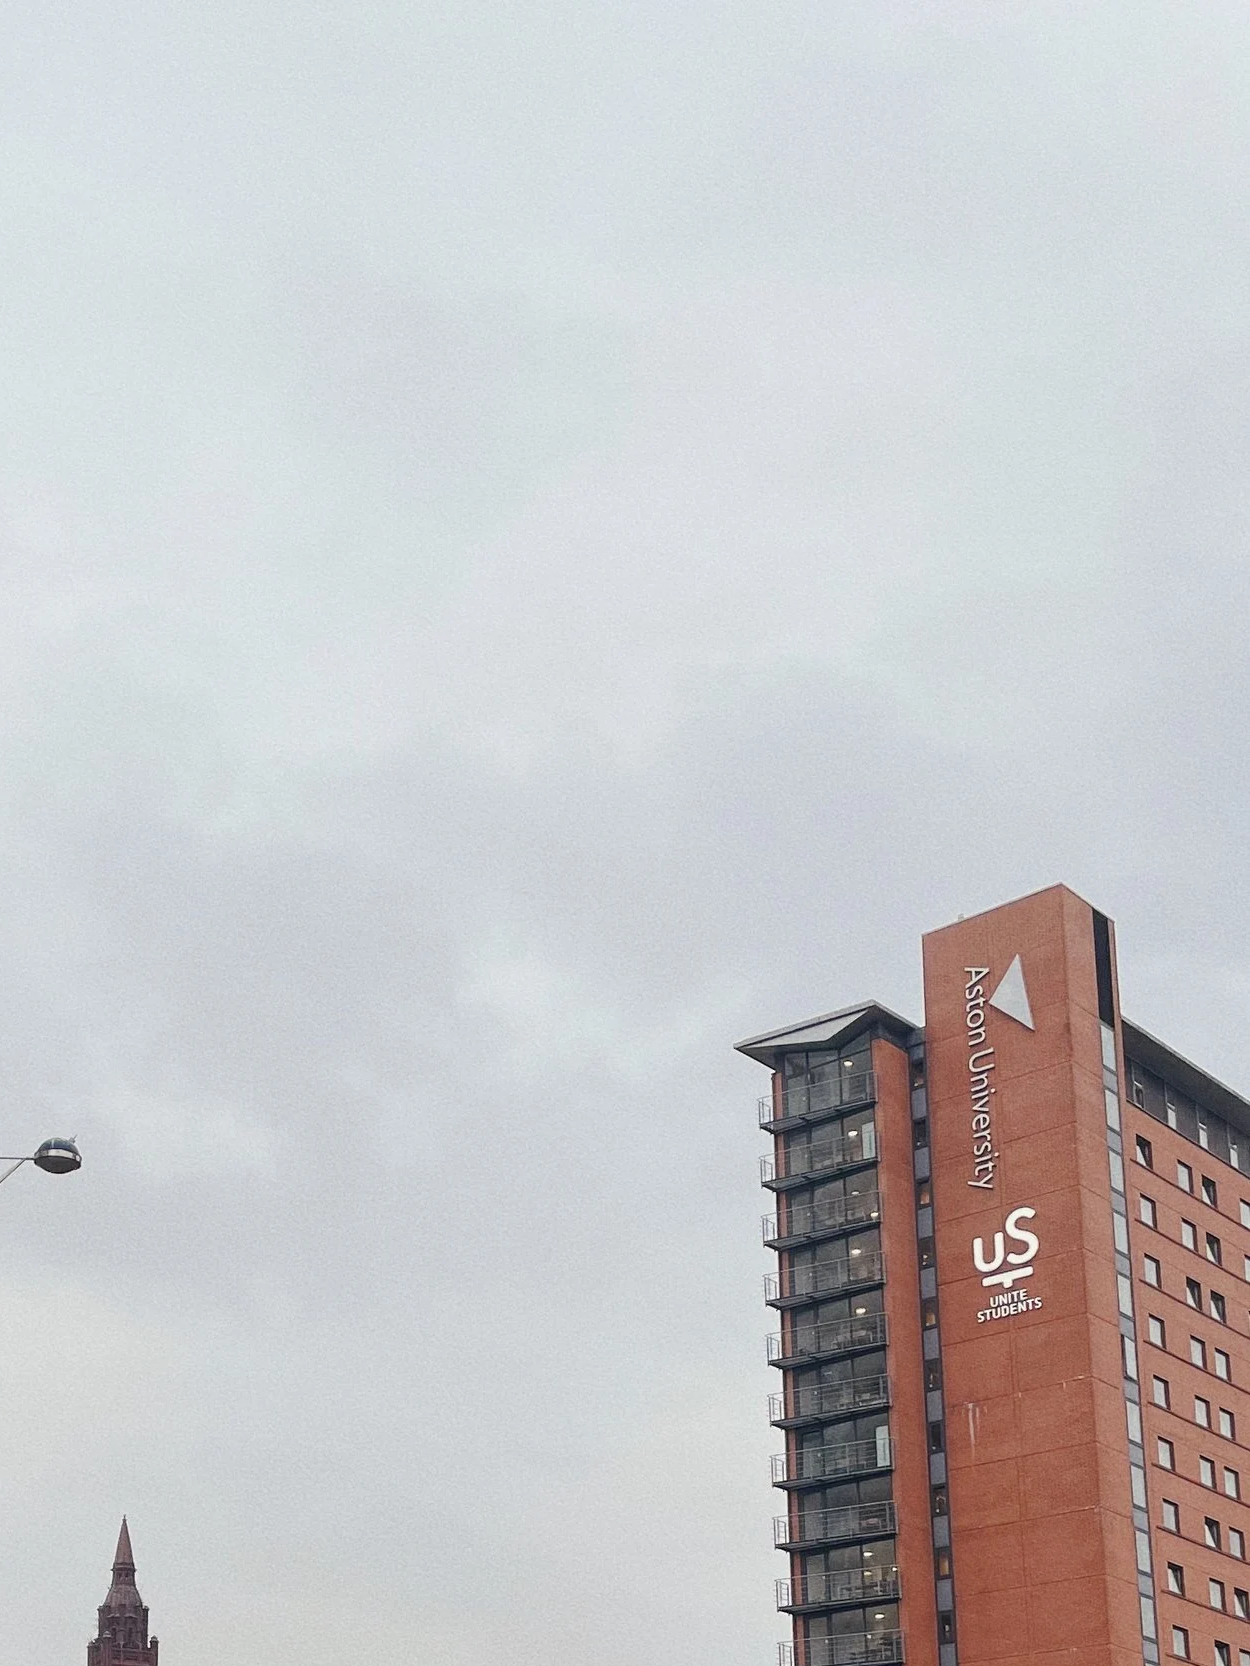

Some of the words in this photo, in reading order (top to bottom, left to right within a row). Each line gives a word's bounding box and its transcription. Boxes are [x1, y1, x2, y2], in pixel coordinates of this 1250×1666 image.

[964, 966, 990, 1047] Aston
[967, 1047, 999, 1189] University
[976, 1296, 1043, 1323] STUDENTS
[989, 1288, 1028, 1308] UNITE
